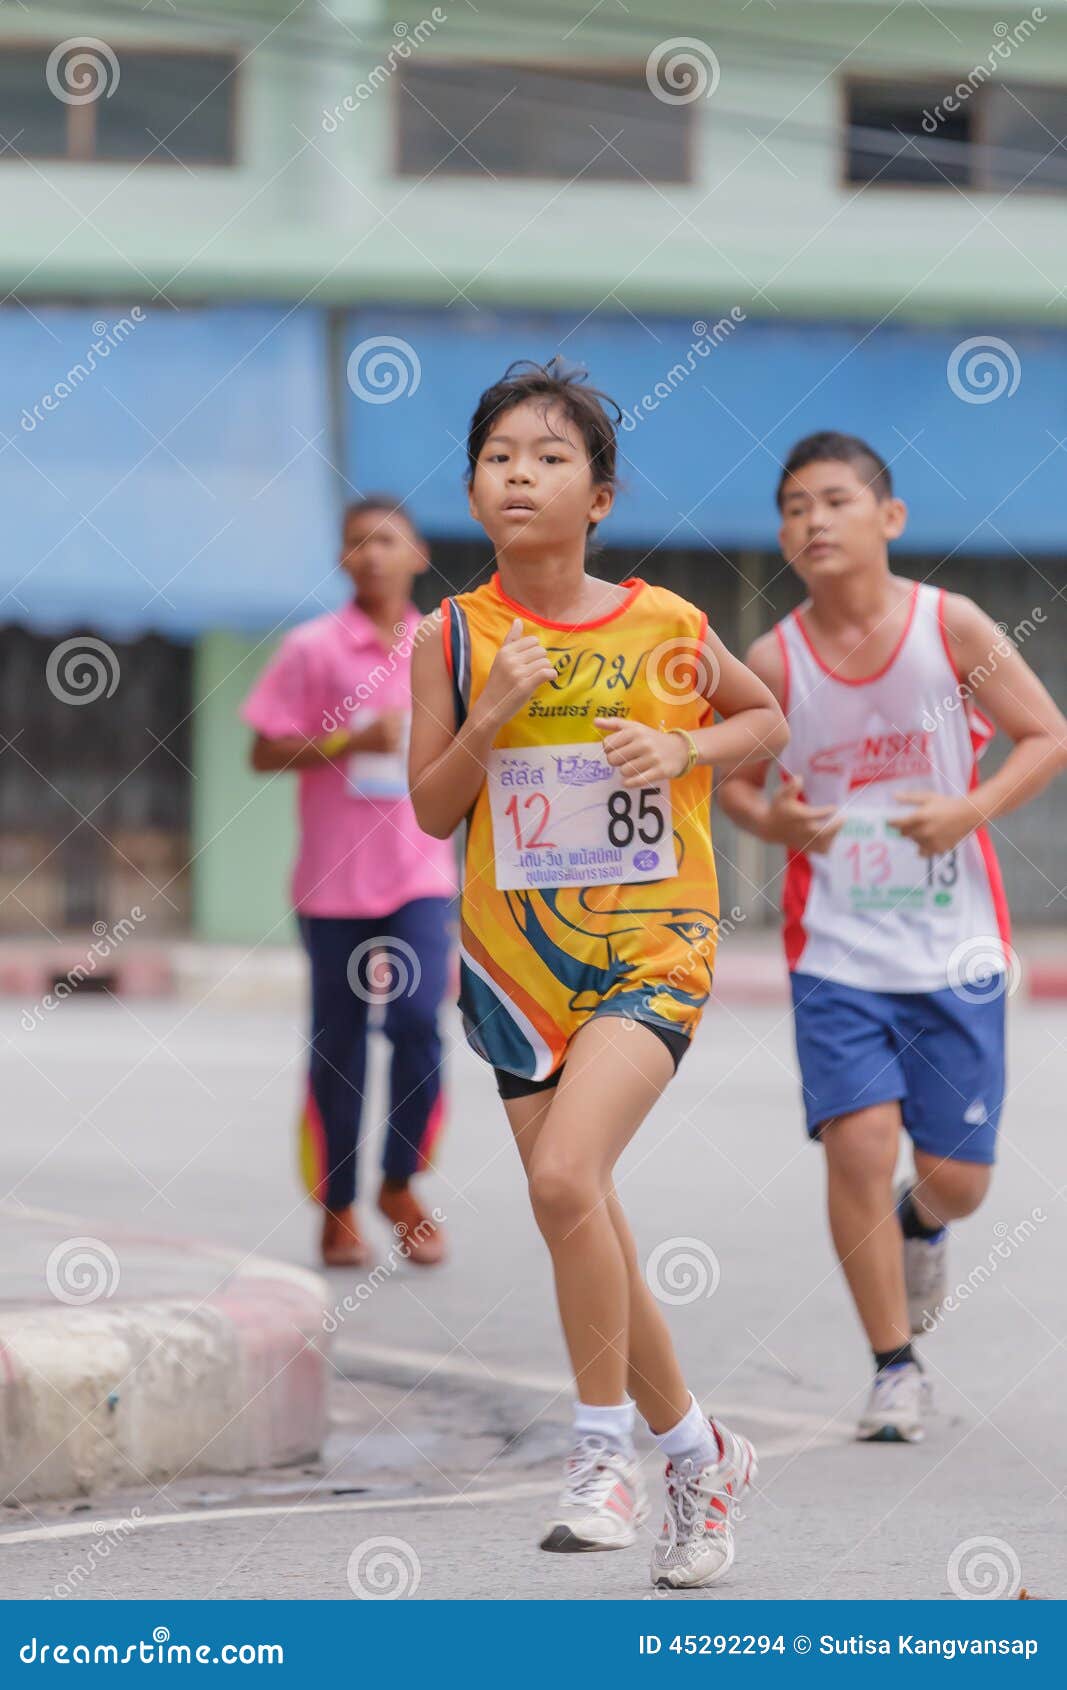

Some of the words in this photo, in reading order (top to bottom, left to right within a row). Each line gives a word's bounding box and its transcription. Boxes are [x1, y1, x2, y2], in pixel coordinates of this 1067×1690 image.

[546, 646, 652, 690] ยาม
[504, 792, 558, 851] 12
[607, 787, 665, 848] 85
